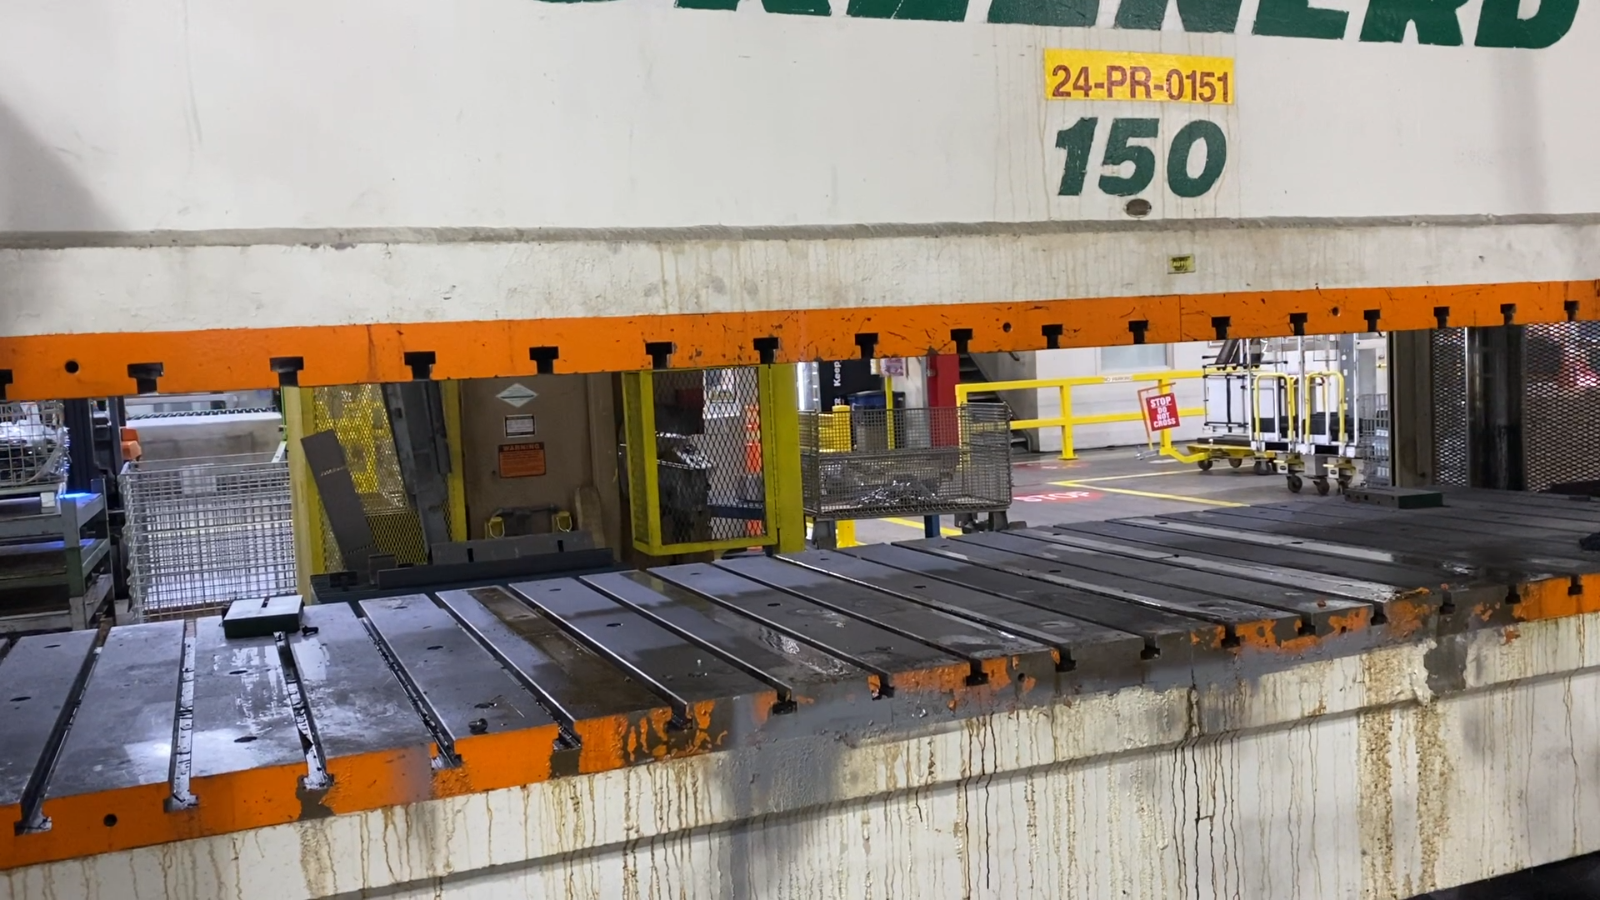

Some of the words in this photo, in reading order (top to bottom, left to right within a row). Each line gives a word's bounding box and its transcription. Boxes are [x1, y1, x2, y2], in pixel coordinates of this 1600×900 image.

[1052, 65, 1229, 103] 24-PR-0151
[1055, 117, 1227, 198] 150
[834, 361, 842, 386] Keep
[1150, 396, 1172, 408] STOP
[1156, 412, 1170, 421] NOT
[1153, 418, 1176, 428] CROSS
[503, 443, 540, 452] WARNING
